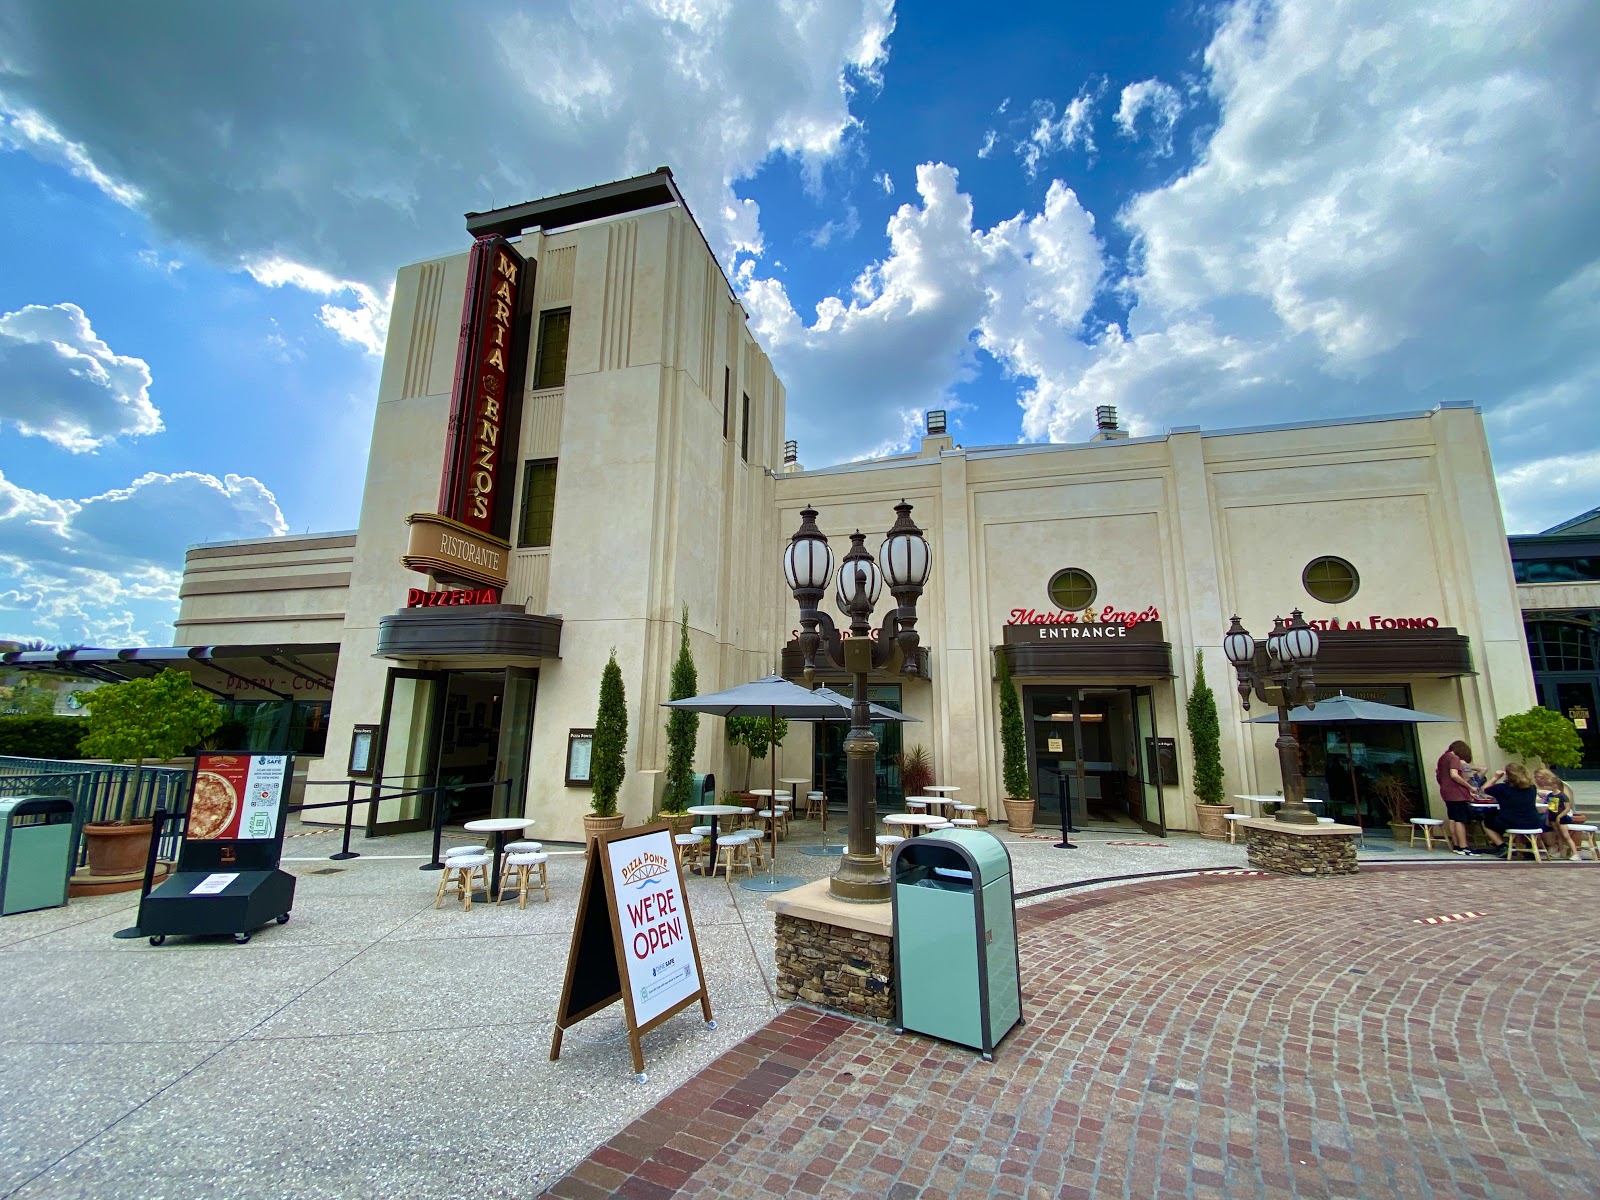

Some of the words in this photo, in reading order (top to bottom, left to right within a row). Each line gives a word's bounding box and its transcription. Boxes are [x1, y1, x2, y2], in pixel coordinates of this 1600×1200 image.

[489, 252, 518, 373] MARIA
[474, 395, 500, 520] ENZO'S
[440, 533, 500, 571] RISTORANTE
[407, 587, 498, 608] PIZZERIA
[1007, 608, 1078, 626] Maria
[1081, 605, 1098, 624] &
[1100, 605, 1160, 629] Enzo's
[1284, 617, 1341, 631] PSTA
[1369, 615, 1439, 630] FORNO
[1039, 626, 1127, 639] ENTRANCE
[621, 856, 643, 879] PIZZA
[643, 852, 668, 868] PONTE
[627, 888, 677, 929] WE'RE
[633, 916, 684, 960] OPEN!
[665, 957, 675, 968] SAFE
